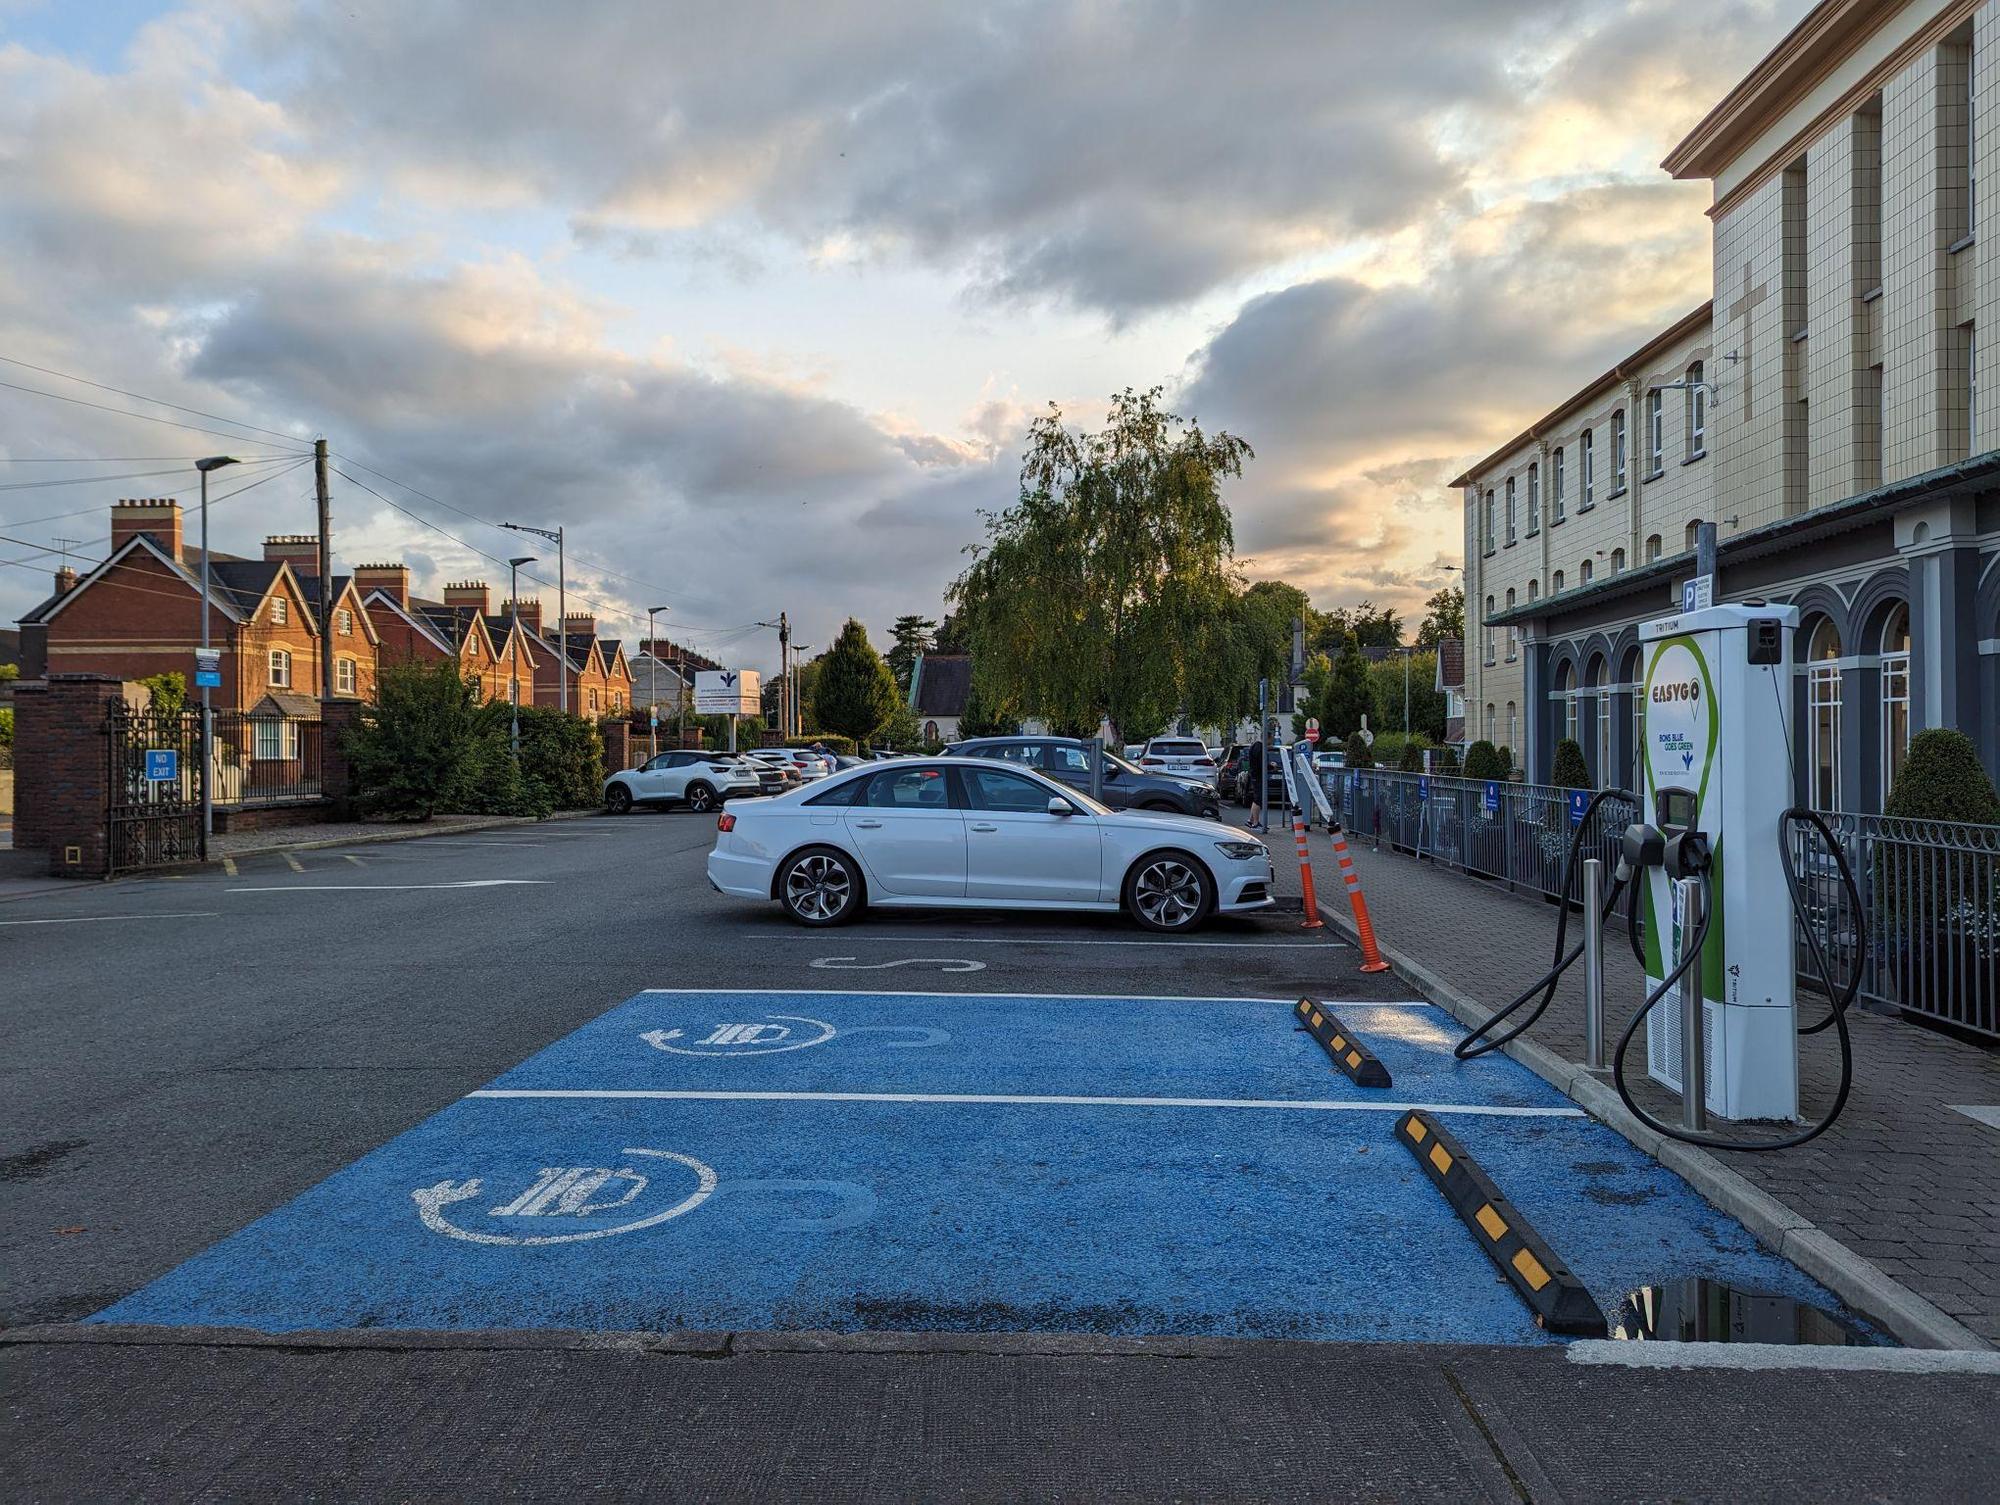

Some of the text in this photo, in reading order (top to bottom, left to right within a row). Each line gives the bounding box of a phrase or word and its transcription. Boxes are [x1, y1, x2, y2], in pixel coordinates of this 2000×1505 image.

[1686, 587, 1694, 609] P
[1656, 620, 1679, 633] TRITIUM
[1652, 681, 1700, 703] EASYGO
[1659, 733, 1684, 742] BONS BLUE
[1665, 742, 1693, 751] GOES GREEN
[155, 754, 167, 763] NO
[153, 767, 170, 777] EXIT
